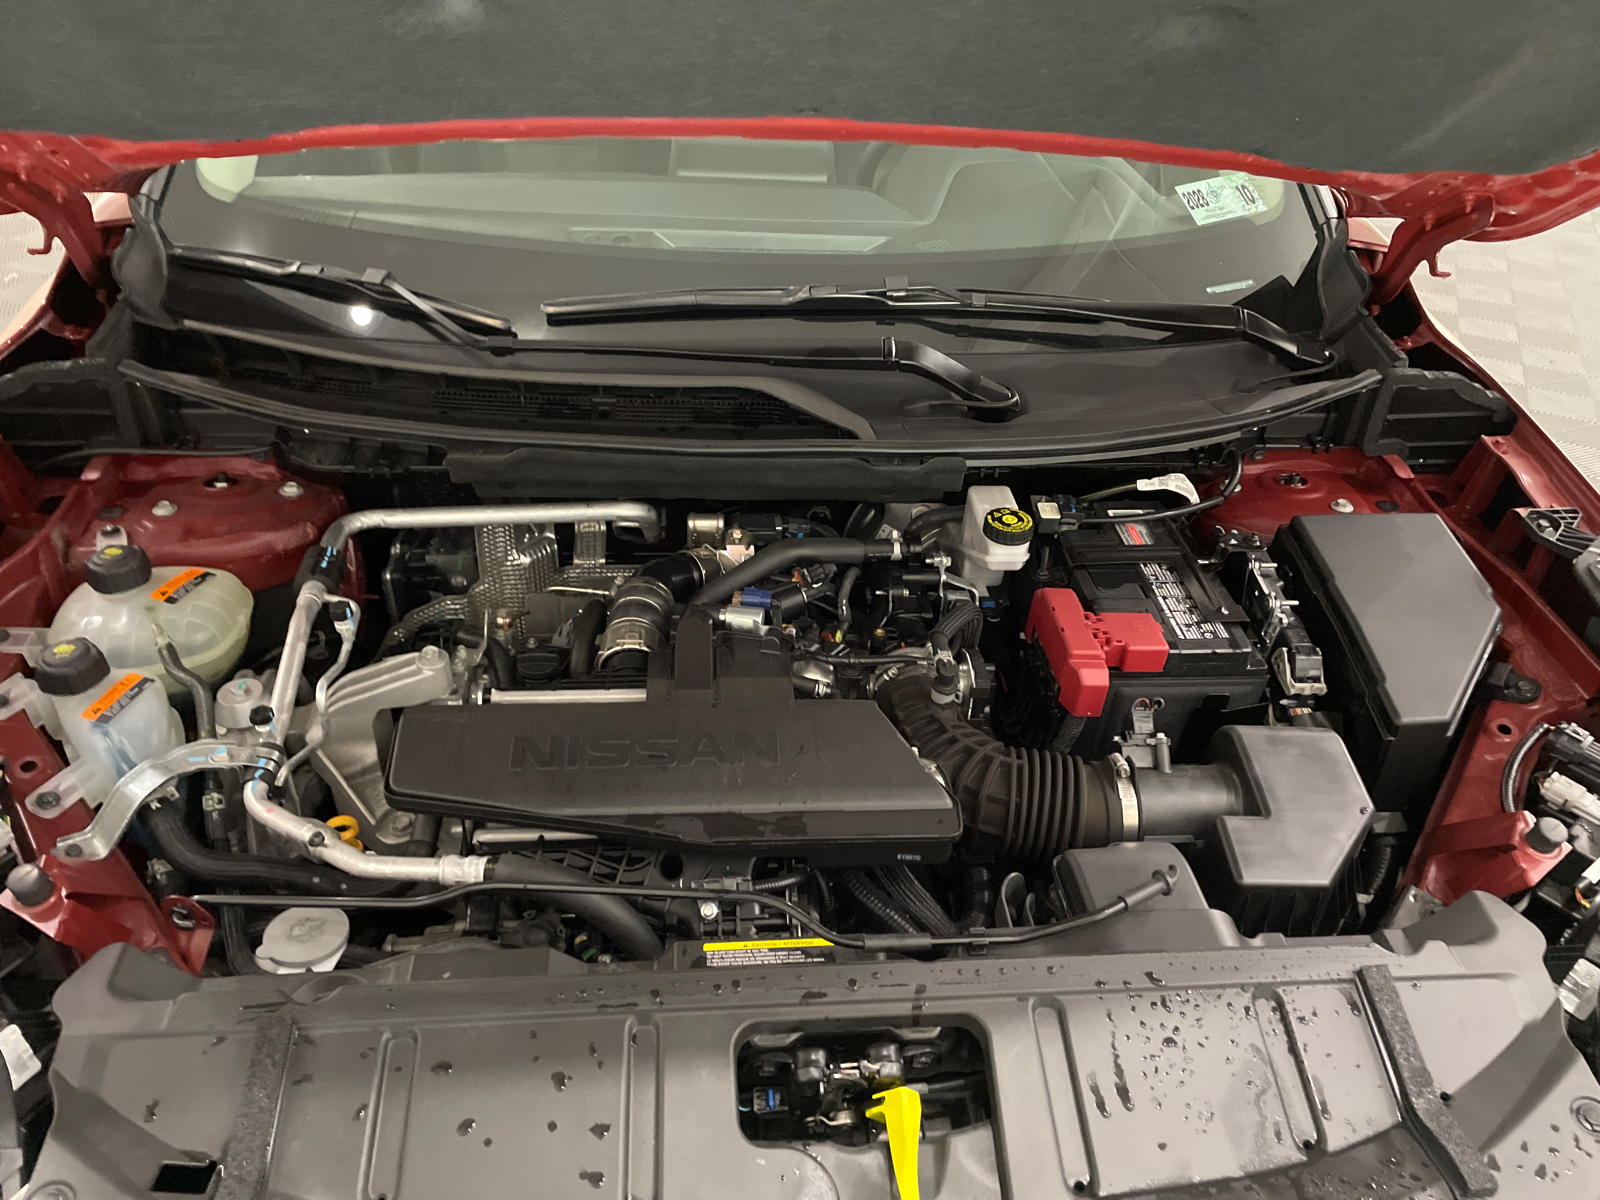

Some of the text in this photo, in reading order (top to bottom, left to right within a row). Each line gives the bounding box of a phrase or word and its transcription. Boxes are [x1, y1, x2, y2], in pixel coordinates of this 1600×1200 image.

[1182, 189, 1209, 210] 2028
[1234, 184, 1256, 205] 10
[508, 731, 780, 771] NISSAN
